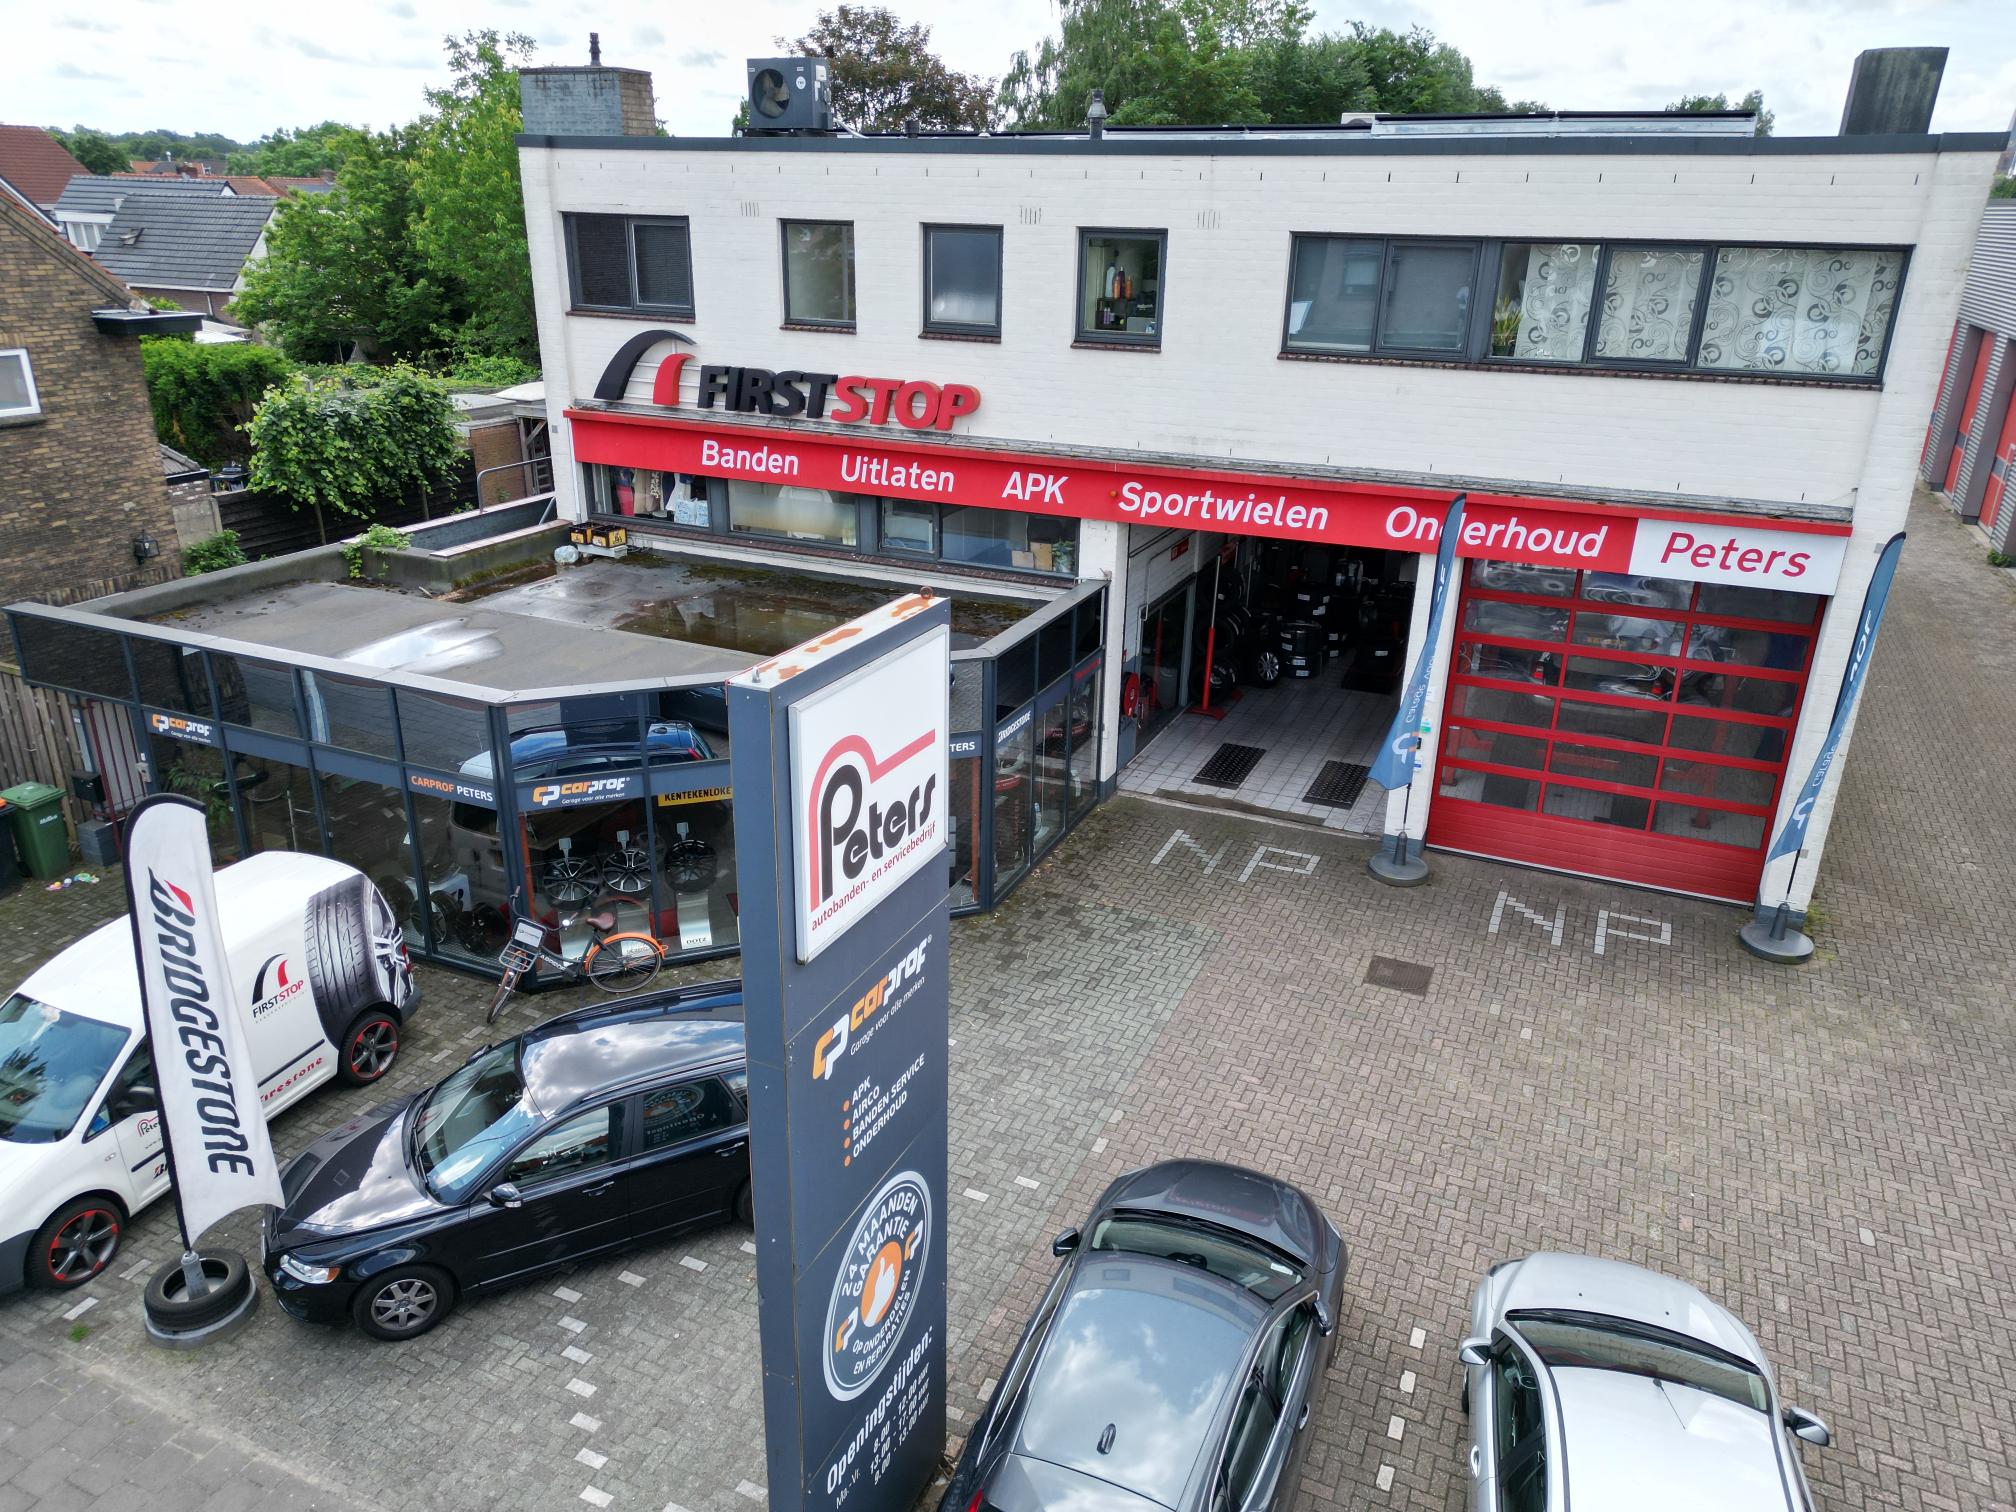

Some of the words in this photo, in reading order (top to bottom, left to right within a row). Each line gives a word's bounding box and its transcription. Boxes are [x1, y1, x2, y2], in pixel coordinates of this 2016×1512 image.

[702, 440, 799, 476] Banden
[841, 454, 954, 493] Uitlaten
[1001, 471, 1069, 504] APK
[1118, 481, 1329, 530] Sportwielen
[1660, 531, 1812, 578] Peters
[561, 777, 626, 794] carprof
[949, 741, 976, 753] TERS
[410, 774, 455, 793] CARPROF
[456, 785, 494, 802] PETERS
[664, 786, 732, 802] KENTEKENLOKE
[820, 764, 936, 903] Peters
[812, 878, 870, 931] autobanden-
[871, 868, 882, 883] en
[884, 820, 936, 873] servicebedrijf
[1488, 891, 1673, 954] NP
[148, 865, 255, 1177] BRIDGESTONE
[252, 980, 304, 1019] FIRSTSTOP
[850, 936, 928, 1032] carprof
[850, 1026, 874, 1056] Garage
[875, 1012, 890, 1030] voor
[890, 999, 902, 1016] alle
[903, 976, 925, 1004] merken
[852, 1075, 871, 1105] APK
[852, 1085, 880, 1122] AIRCO
[853, 1096, 890, 1140] BANDEN
[891, 1052, 926, 1098] SERVICE
[853, 1090, 908, 1158] ONDERHOUD
[842, 1264, 856, 1296] 24
[858, 1191, 918, 1256] MAANDEN
[852, 1216, 910, 1297] GARANTIE
[852, 1340, 864, 1355] OP
[853, 1359, 865, 1375] EN
[865, 1292, 910, 1366] REPARATIES
[827, 1325, 933, 1495] Openingstijden:
